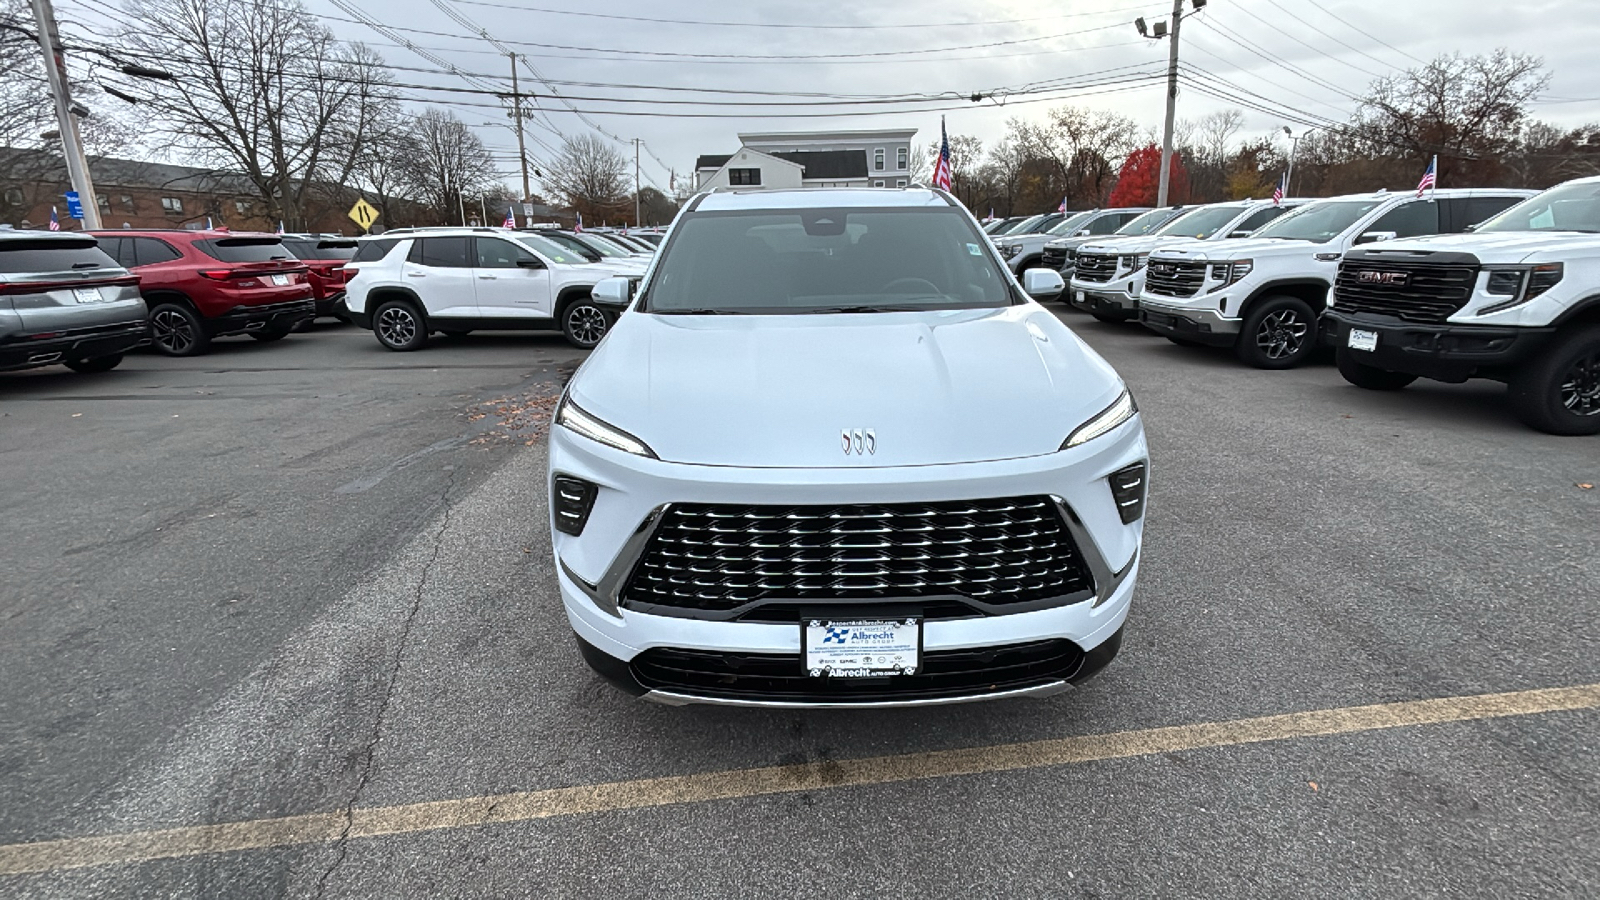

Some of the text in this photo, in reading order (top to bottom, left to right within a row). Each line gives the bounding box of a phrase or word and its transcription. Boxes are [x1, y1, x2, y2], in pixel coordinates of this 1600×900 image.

[1359, 271, 1408, 285] GMC
[851, 632, 894, 640] Albrecht
[828, 668, 871, 678] Albrecht
